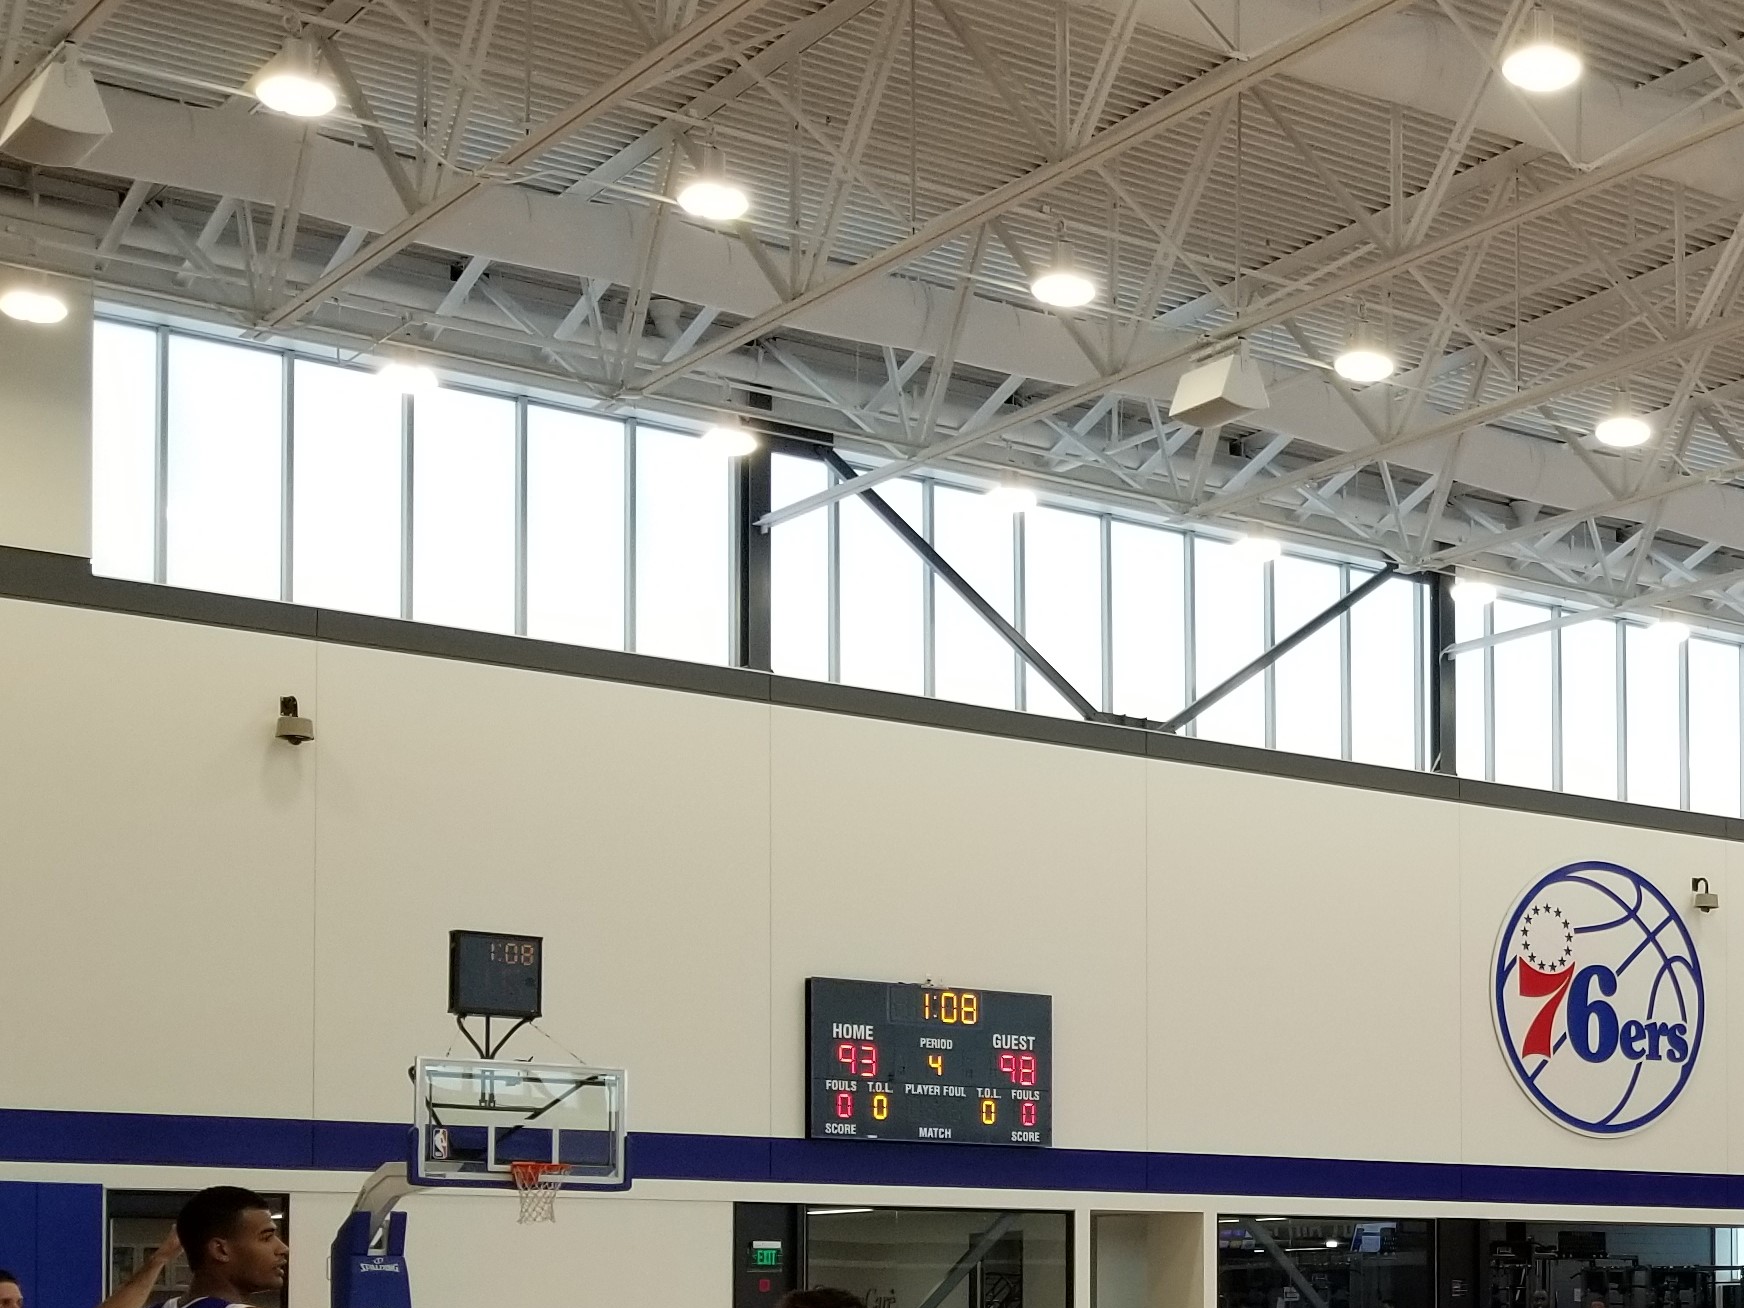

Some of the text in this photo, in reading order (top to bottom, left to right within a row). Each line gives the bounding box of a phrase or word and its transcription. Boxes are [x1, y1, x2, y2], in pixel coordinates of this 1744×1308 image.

[490, 943, 534, 965] 1:08
[924, 992, 977, 1024] 1:08
[1518, 955, 1689, 1064] 76ers
[832, 1023, 874, 1040] HOME
[920, 1038, 953, 1050] PERIOD
[992, 1034, 1035, 1051] GUEST
[838, 1044, 877, 1077] 93
[928, 1055, 942, 1076] 4
[1000, 1054, 1036, 1086] 98
[825, 1080, 857, 1092] FOULS
[867, 1082, 893, 1094] T.O.L.
[905, 1084, 966, 1097] PLAYER FOUL
[977, 1088, 1002, 1099] T.O.L.
[1011, 1089, 1040, 1101] FOULS
[837, 1093, 852, 1118] 0
[873, 1094, 888, 1120] 0
[981, 1100, 995, 1125] 0
[1022, 1102, 1036, 1126] 0
[825, 1123, 856, 1135] SCORE
[919, 1127, 951, 1139] MATCH
[1011, 1131, 1040, 1142] SCORE
[757, 1250, 776, 1265] EXIT
